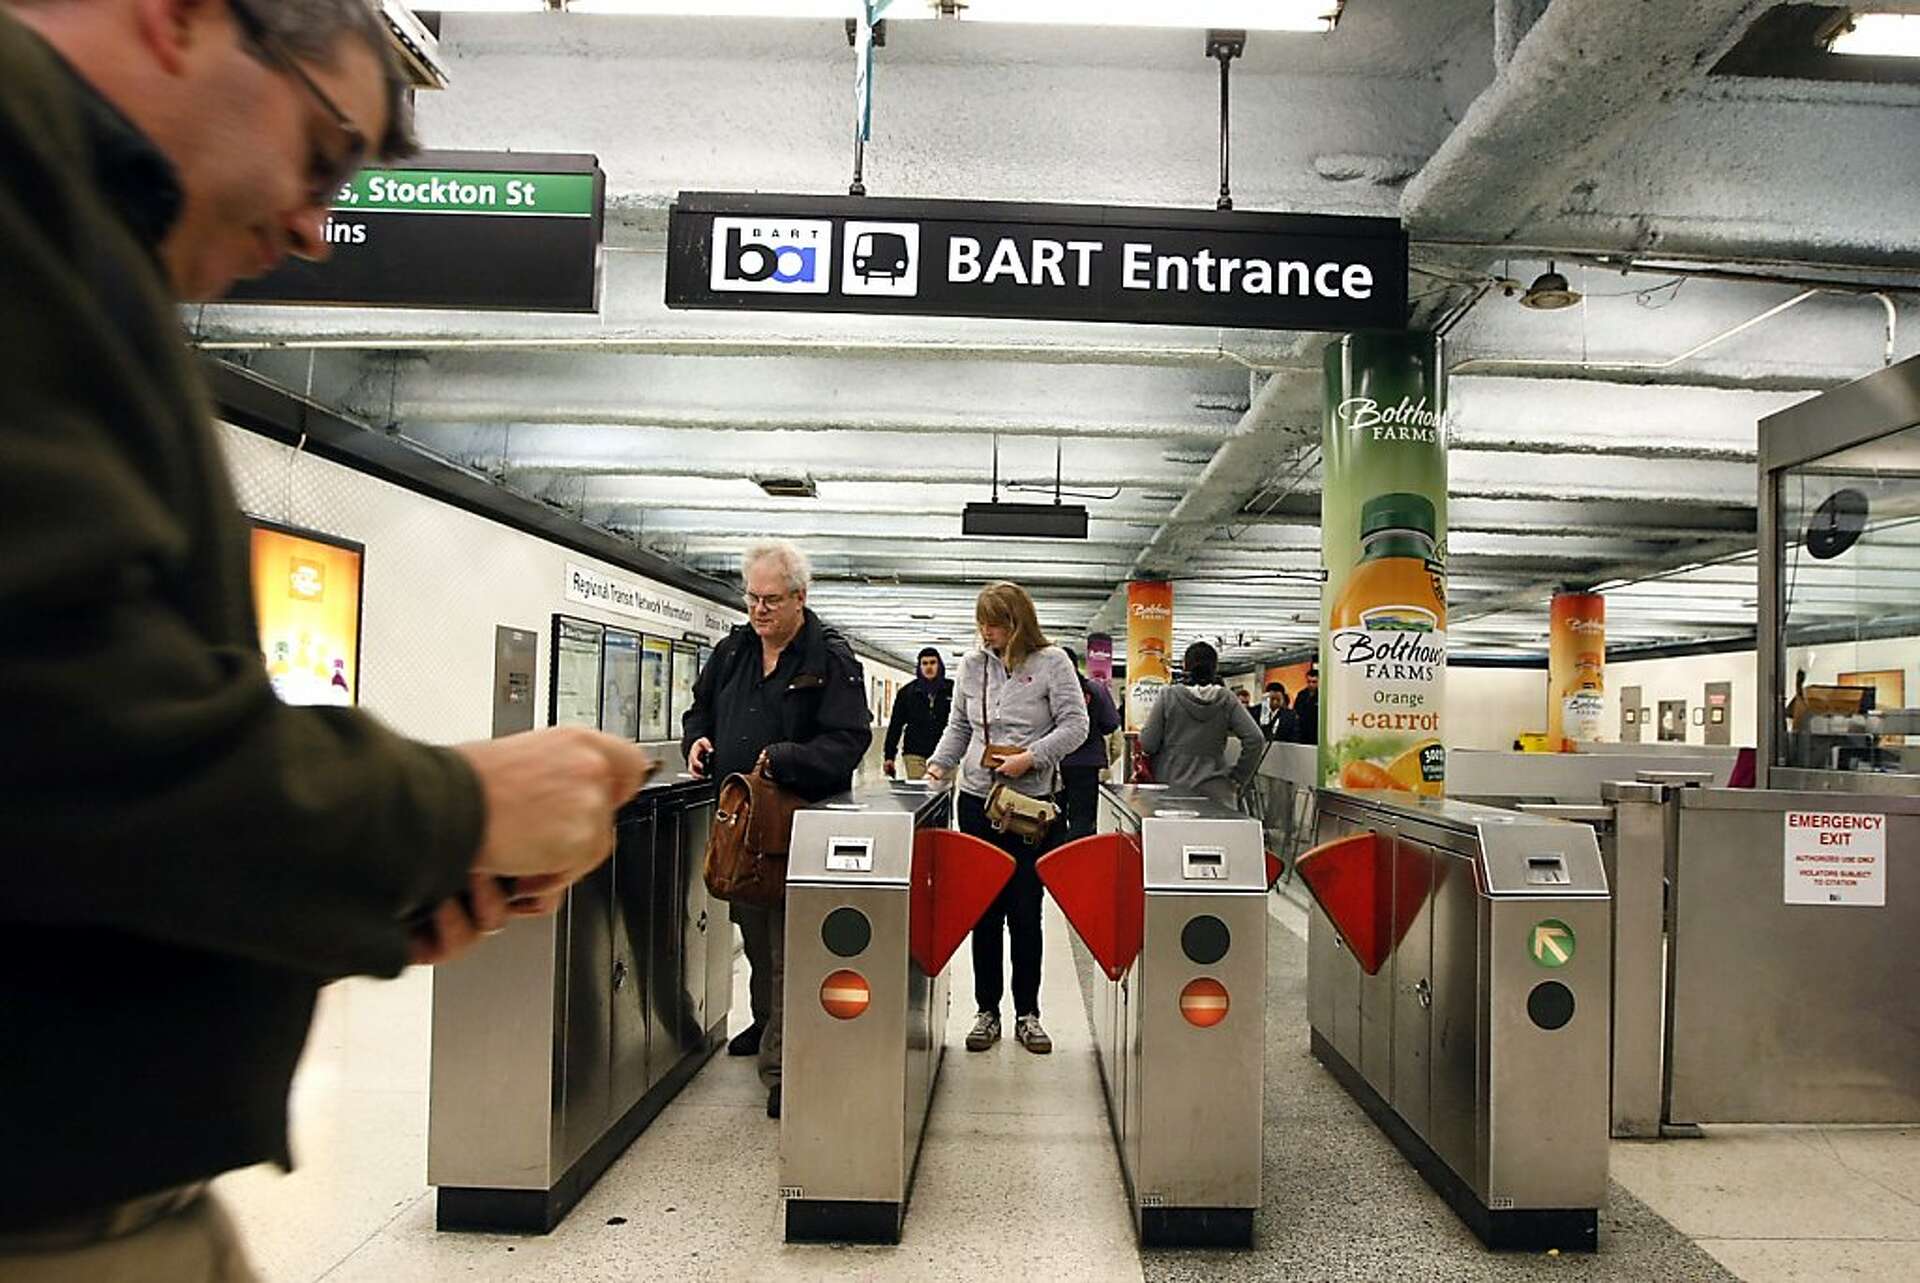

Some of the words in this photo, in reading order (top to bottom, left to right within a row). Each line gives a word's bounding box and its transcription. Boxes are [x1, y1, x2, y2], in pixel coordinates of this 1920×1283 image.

[369, 176, 496, 205] Stockton
[505, 180, 536, 206] St
[319, 216, 367, 244] ins
[752, 228, 818, 239] BART
[947, 236, 1103, 289] BART
[1121, 242, 1374, 300] Entrance
[1373, 426, 1435, 443] FARMS
[573, 571, 609, 599] Regional
[611, 583, 634, 607] Transit
[635, 591, 661, 614] Network
[662, 600, 693, 622] Information
[1366, 663, 1433, 681] FARMS
[1373, 690, 1424, 707] Orange
[1347, 711, 1440, 731] +carrot
[1789, 814, 1882, 829] EMERGENCY
[1820, 832, 1852, 845] EXIT
